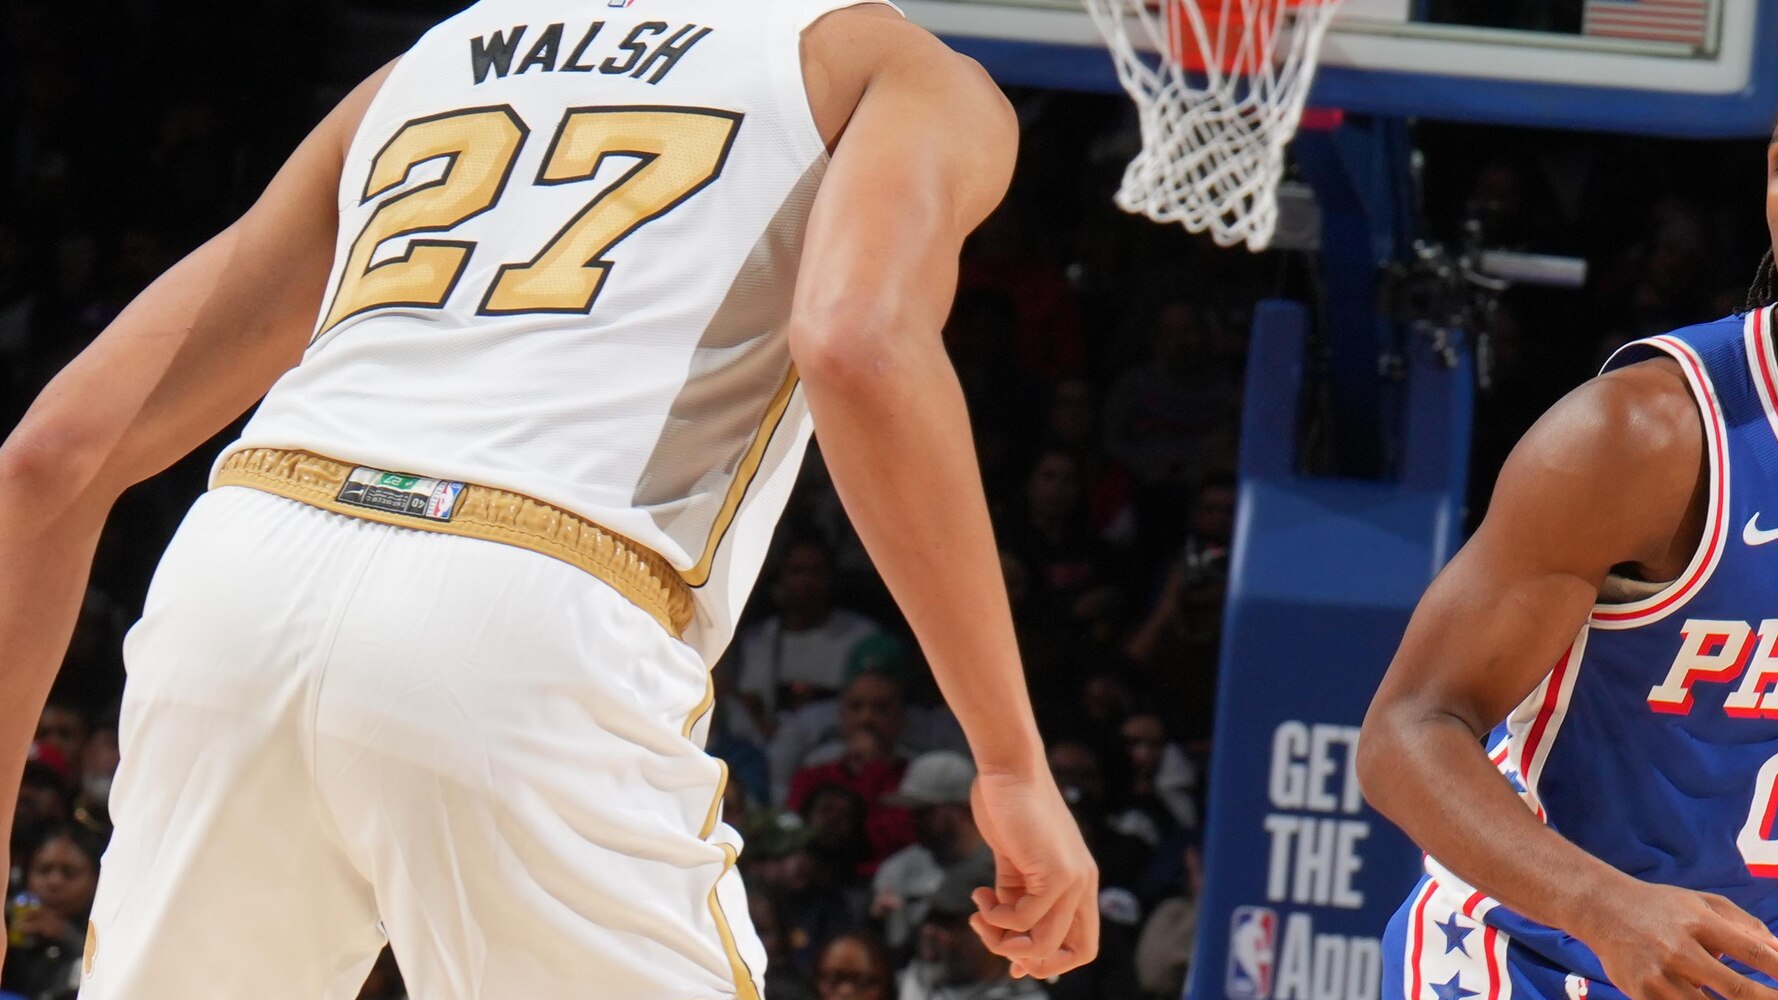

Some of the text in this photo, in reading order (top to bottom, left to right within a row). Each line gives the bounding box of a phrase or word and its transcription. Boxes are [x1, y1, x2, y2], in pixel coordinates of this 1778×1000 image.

[469, 20, 714, 85] WALSH
[307, 103, 745, 348] 27
[1270, 721, 1363, 813] GET
[1264, 813, 1370, 909] THE
